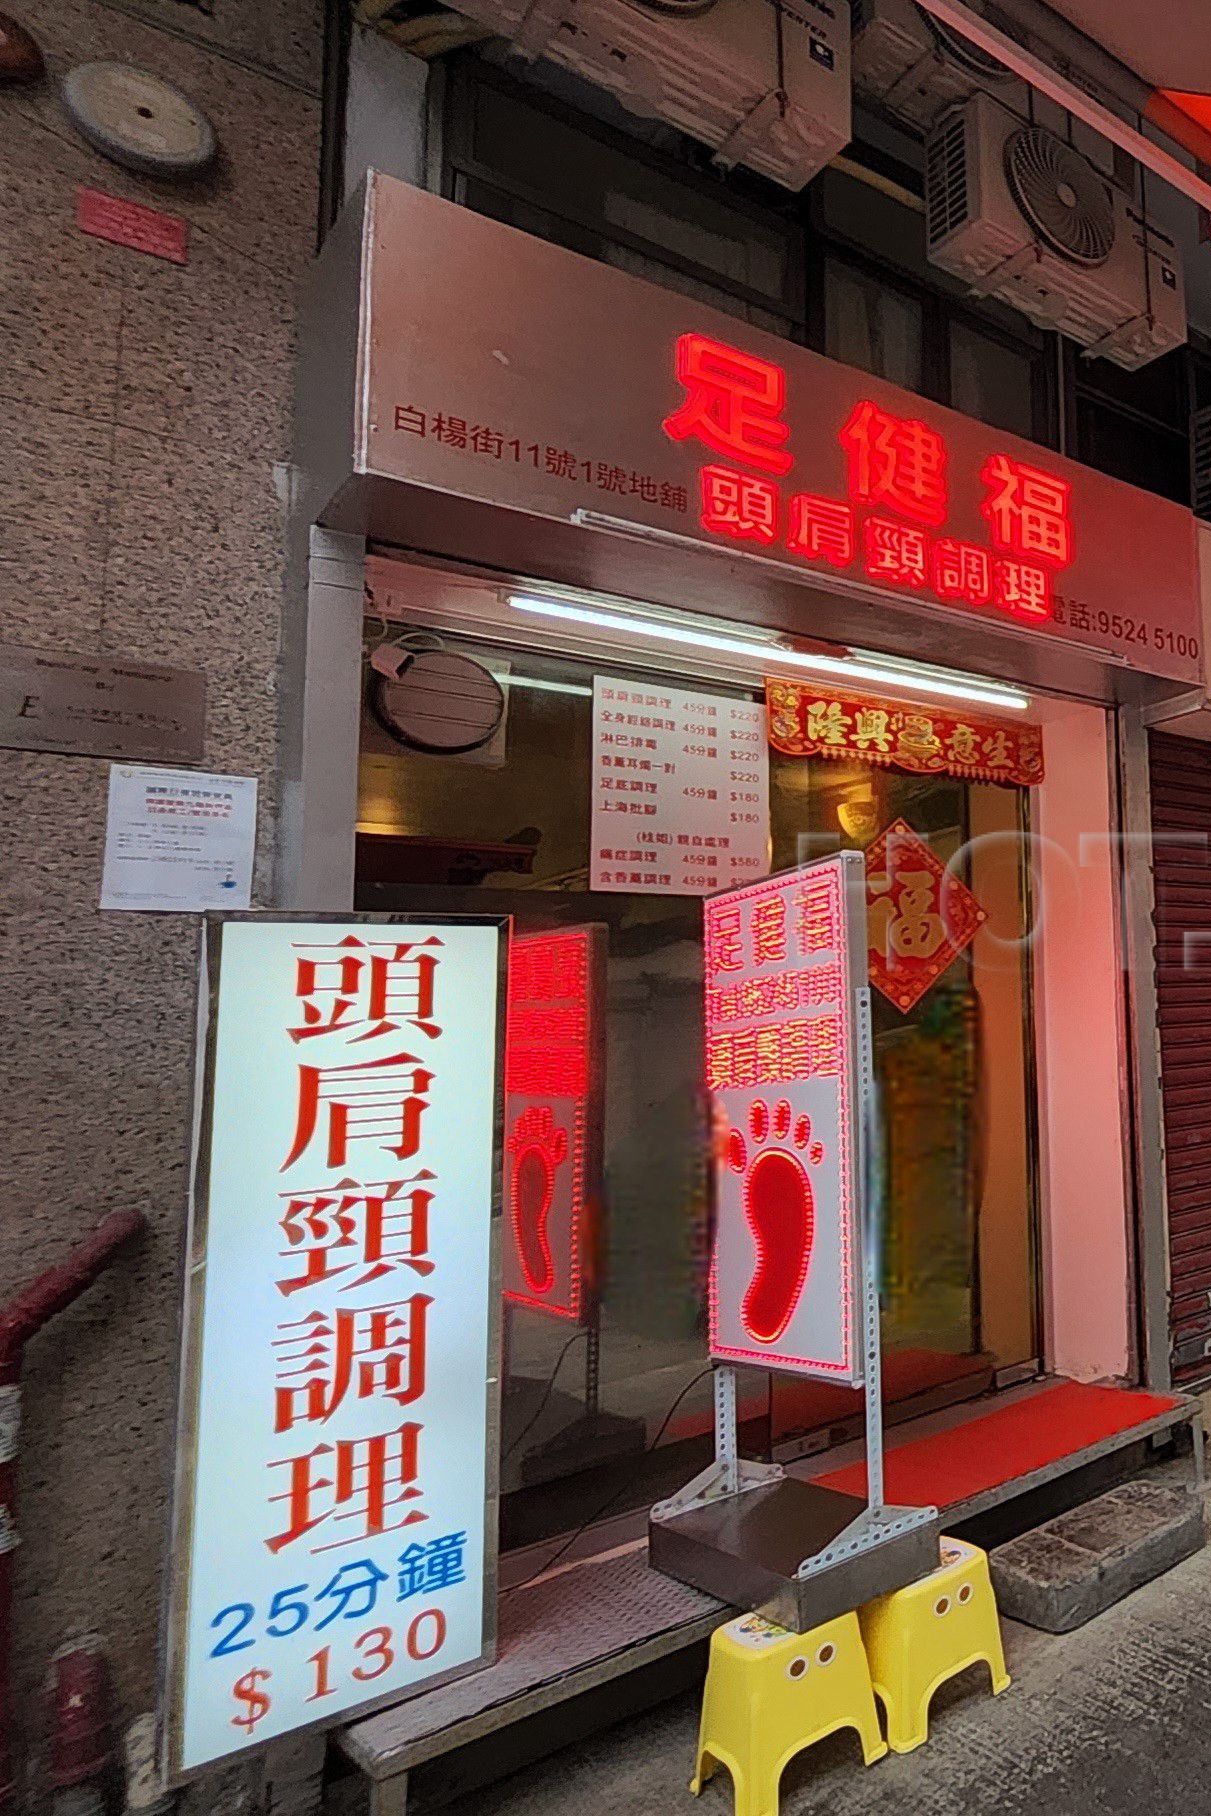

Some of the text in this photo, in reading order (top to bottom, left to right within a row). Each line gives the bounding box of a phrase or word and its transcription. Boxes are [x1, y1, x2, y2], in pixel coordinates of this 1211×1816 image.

[394, 404, 688, 512] 白楊街11號1號地舖
[662, 333, 1074, 569] 足健福
[700, 464, 1052, 622] 頭肩頸調理
[1154, 627, 1199, 660] 5100
[729, 709, 760, 723] $220
[729, 730, 760, 742] $220
[729, 750, 760, 762] $220
[729, 771, 760, 783] $220
[729, 791, 760, 803] $180
[729, 812, 760, 824] $180
[867, 871, 948, 958] 福
[264, 934, 446, 1556] 頭肩頸調理
[209, 1531, 468, 1659] 25分鐘
